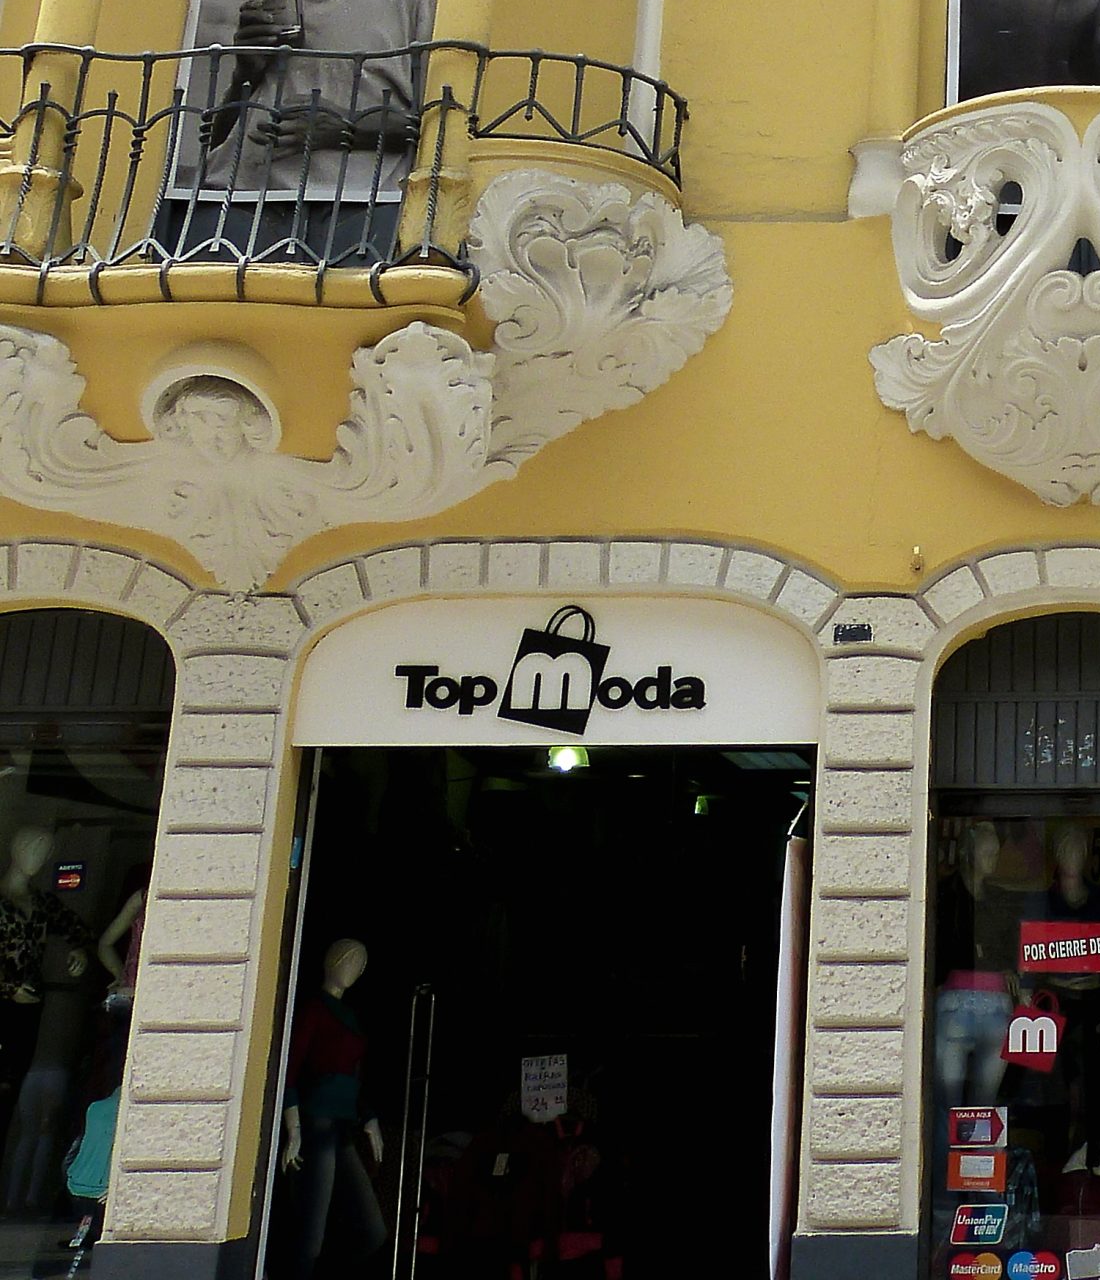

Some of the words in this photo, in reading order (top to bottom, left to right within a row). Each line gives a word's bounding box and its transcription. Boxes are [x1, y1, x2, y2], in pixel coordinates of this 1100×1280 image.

[395, 664, 498, 715] Top
[1023, 944, 1047, 962] POR
[1048, 939, 1088, 959] CIERRE
[957, 1215, 1002, 1226] UnionPay
[950, 1264, 1001, 1274] MasterCard
[1012, 1263, 1056, 1273] Maestro
